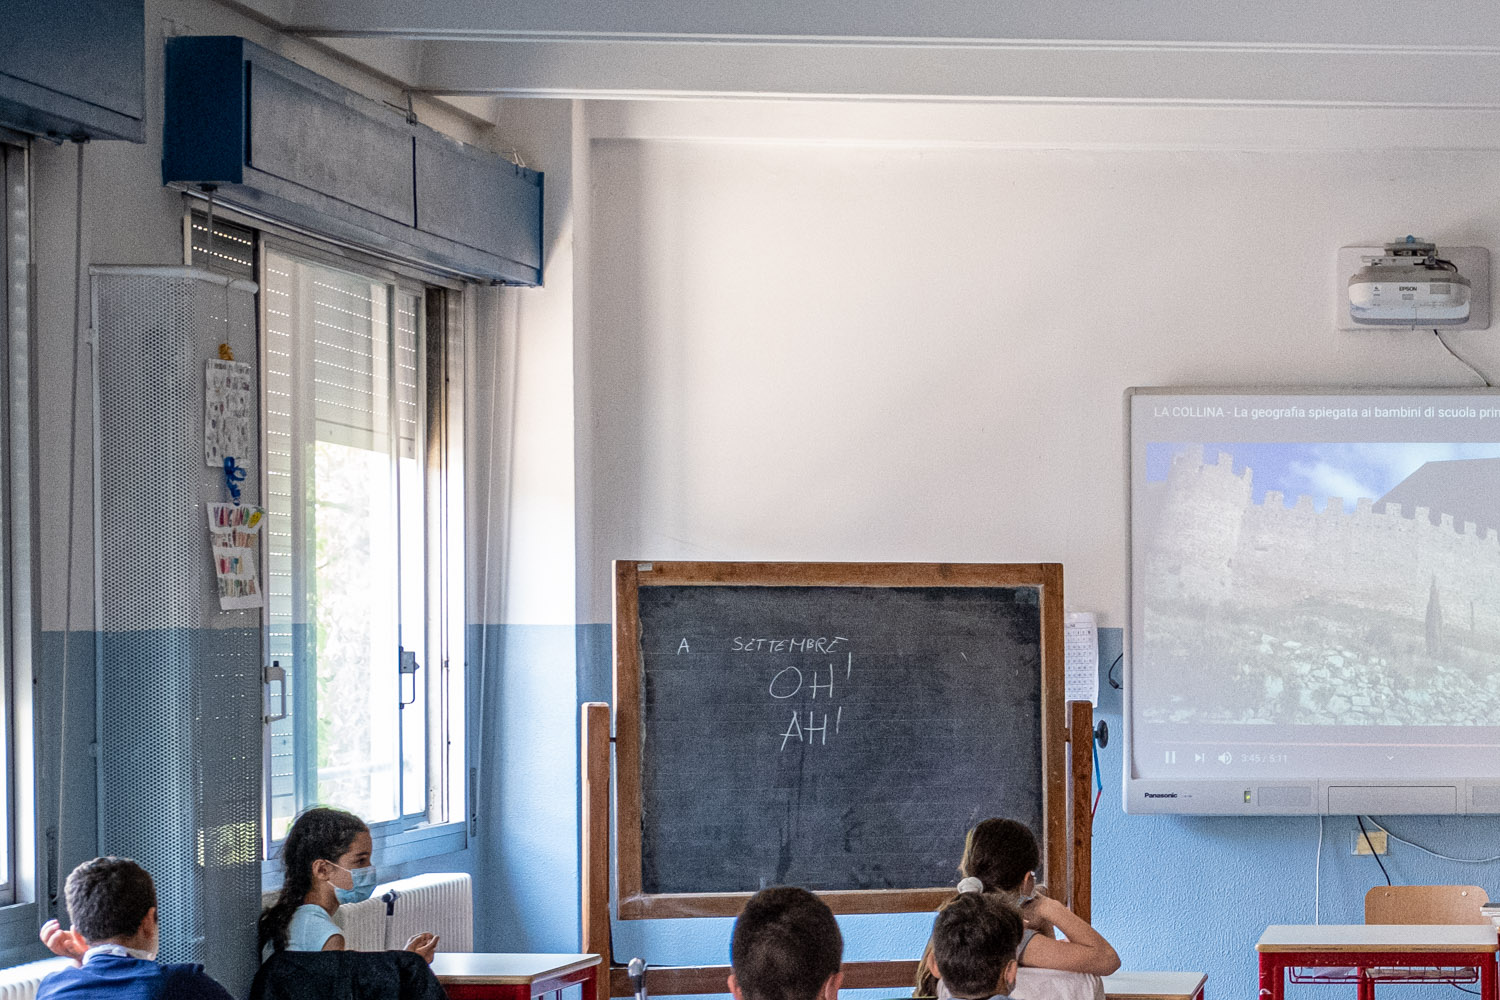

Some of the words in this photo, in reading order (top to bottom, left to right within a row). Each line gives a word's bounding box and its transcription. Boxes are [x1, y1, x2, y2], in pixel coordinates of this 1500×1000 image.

[1154, 406, 1170, 418] LA
[1172, 406, 1225, 418] COLLINA
[1234, 406, 1248, 418] La
[1251, 405, 1306, 420] geografia
[1308, 406, 1358, 420] spiegata
[1361, 406, 1371, 418] ai
[1374, 406, 1421, 418] bambini
[1424, 406, 1435, 418] di
[1438, 406, 1476, 418] scuola
[677, 637, 690, 655] A
[731, 636, 849, 655] SETTEMBRE
